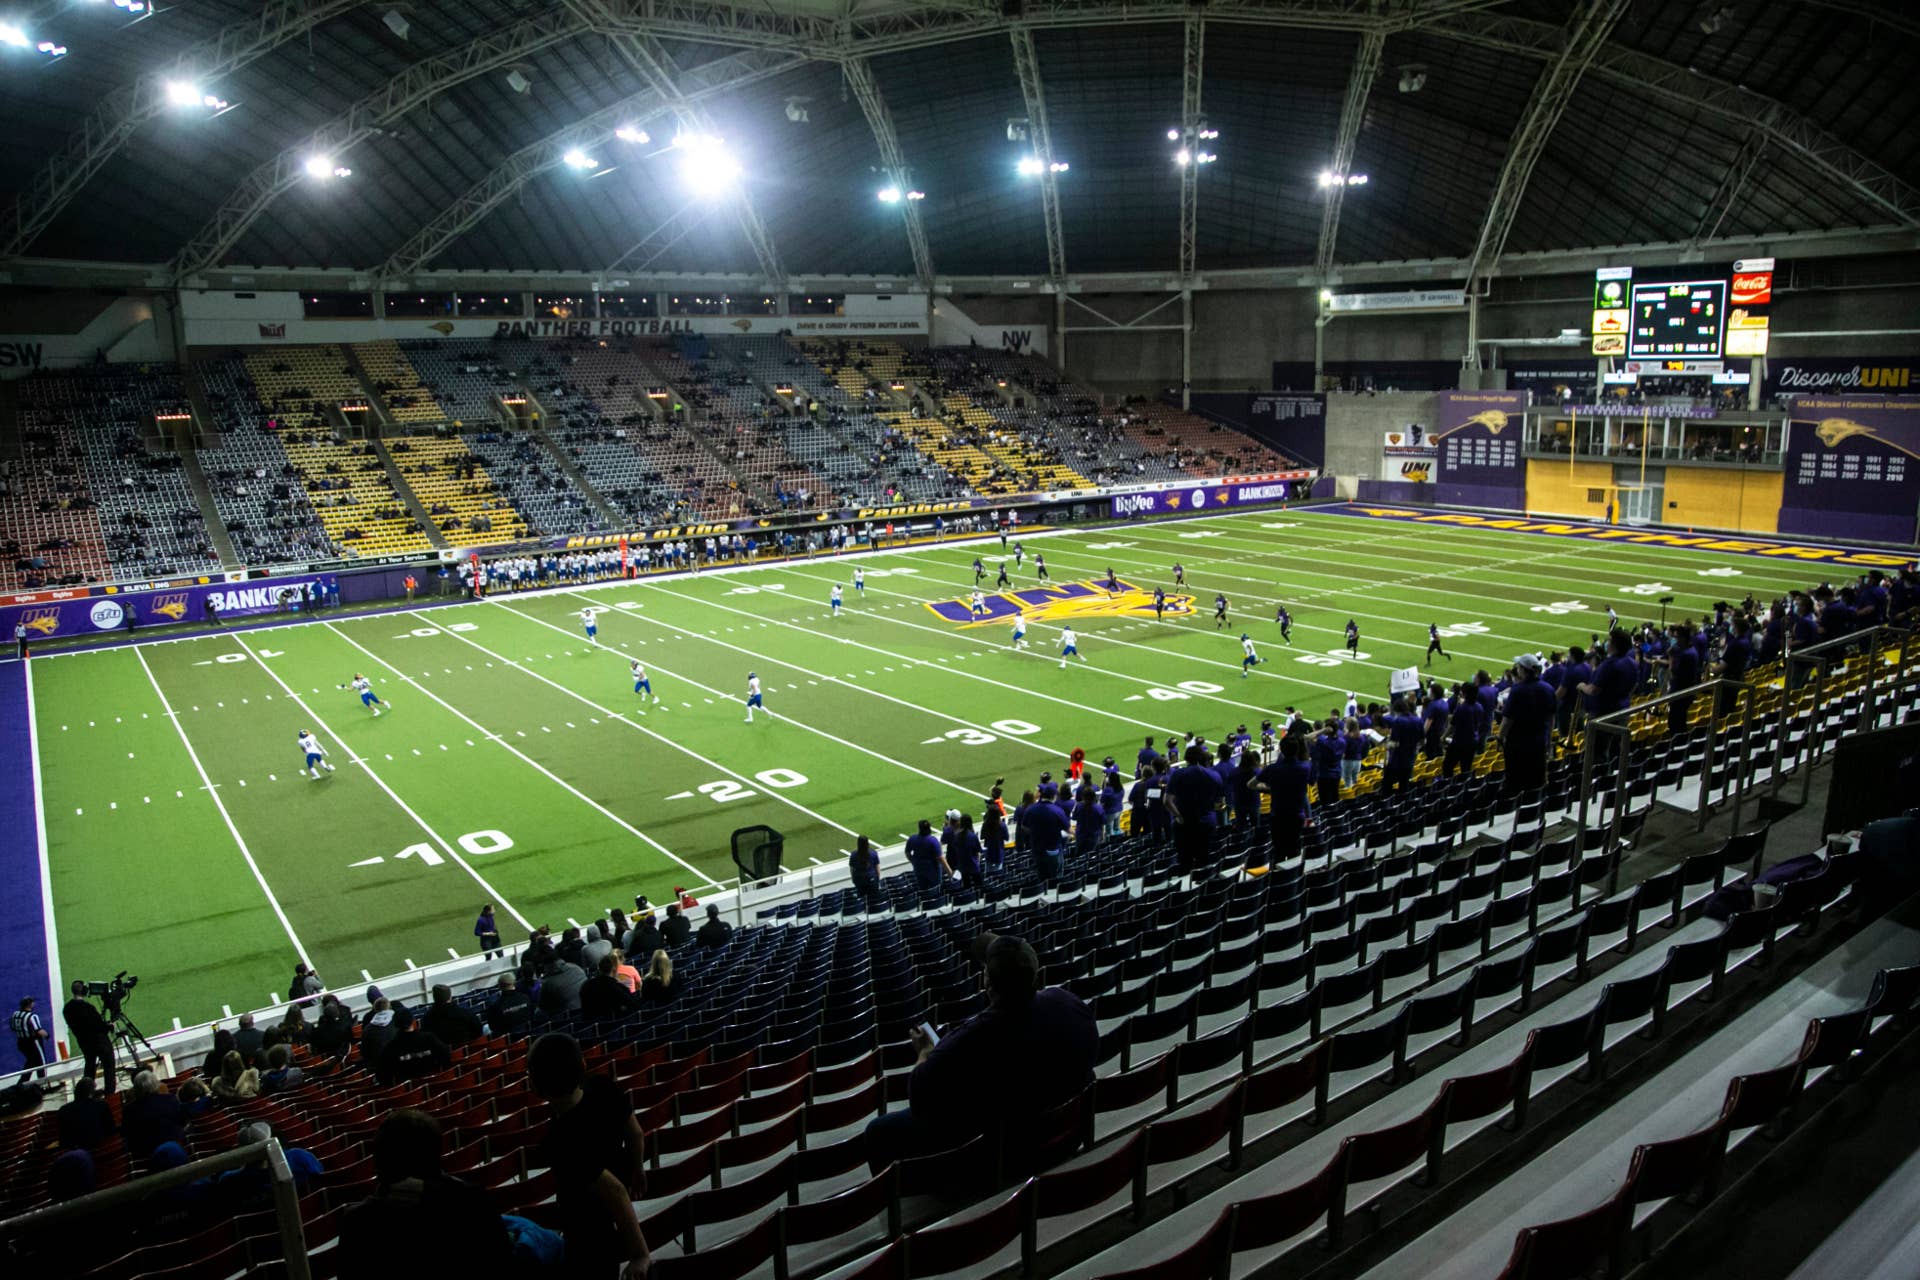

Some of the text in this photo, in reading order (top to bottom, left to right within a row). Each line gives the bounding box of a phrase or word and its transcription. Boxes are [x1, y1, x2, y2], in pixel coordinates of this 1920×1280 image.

[1644, 305, 1652, 318] 7
[498, 319, 694, 336] PANTHER FOOTBALL
[1003, 330, 1032, 347] NW
[0, 343, 42, 366] SW
[1861, 368, 1909, 387] UNI
[1401, 462, 1431, 474] UNI
[858, 500, 972, 519] Panthers
[567, 523, 728, 548] Home of the
[1414, 514, 1920, 566] PANTHERS
[388, 555, 404, 563] Your
[405, 553, 428, 562] Service.
[152, 593, 189, 609] UNI
[923, 577, 1144, 623] UNI
[21, 607, 61, 626] UNI
[1294, 648, 1371, 667] 50
[1145, 680, 1225, 702] 40
[943, 718, 1042, 746] 30
[697, 768, 809, 803] 20
[393, 829, 515, 867] 10
